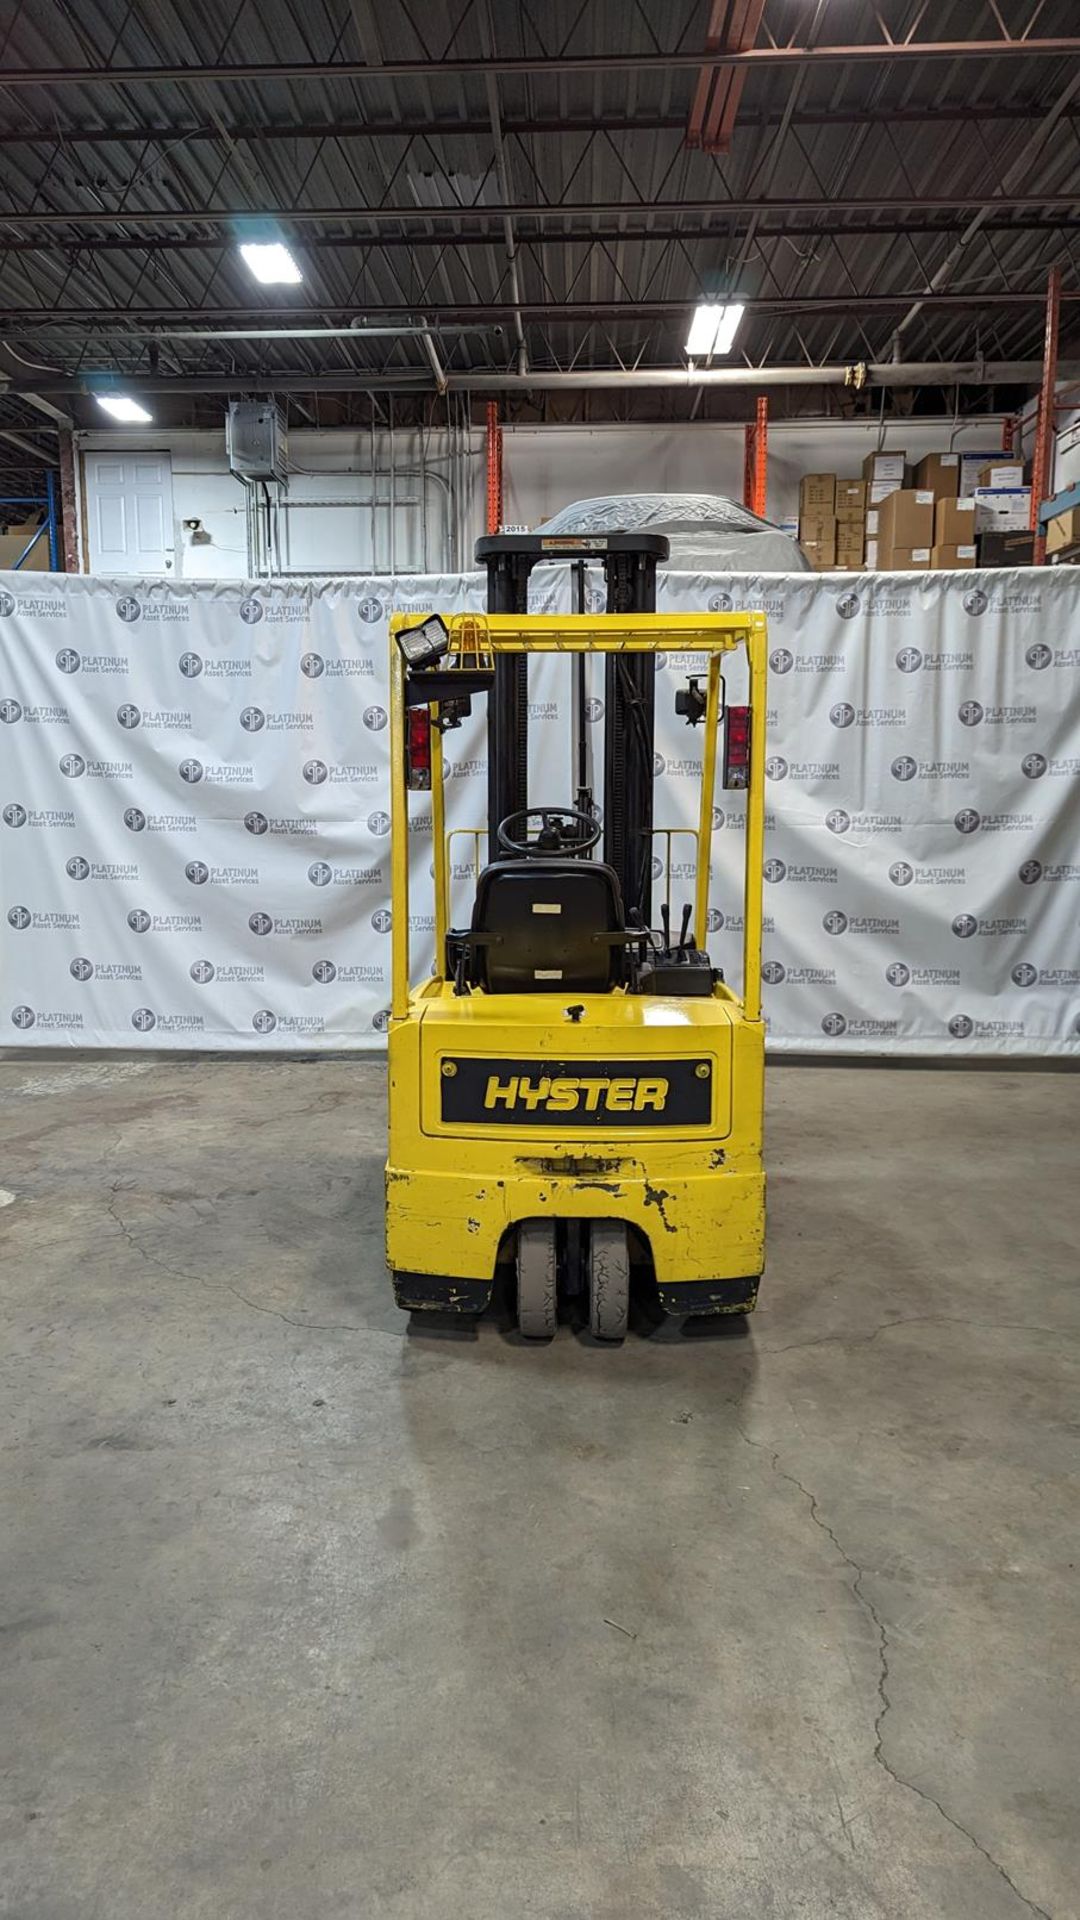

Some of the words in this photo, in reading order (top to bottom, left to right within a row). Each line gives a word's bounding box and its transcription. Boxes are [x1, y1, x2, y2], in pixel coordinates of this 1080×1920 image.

[17, 600, 66, 610] PLATINUM
[142, 605, 189, 614] PLATINUM
[385, 604, 432, 612] PLATINUM
[735, 600, 784, 610] PLATINUM
[17, 610, 37, 618] Asset
[39, 610, 67, 618] Services
[81, 657, 128, 666] PLATINUM
[668, 654, 709, 663] PLATINU
[795, 656, 845, 665] PLATINUM
[205, 660, 251, 669] PLATINUM
[326, 659, 373, 669] PLATINUM
[81, 666, 100, 674] Asset
[102, 666, 129, 674] Services
[204, 669, 223, 677] Asset
[224, 669, 252, 677] Services
[23, 706, 68, 717] PLATINUM
[23, 716, 41, 724] Asset
[43, 716, 70, 724] Services
[142, 712, 191, 721] PLATINUM
[266, 714, 313, 723] PLATINUM
[142, 720, 161, 729] Asset
[163, 720, 192, 729] Services
[266, 722, 284, 730] Asset
[286, 722, 314, 730] Services
[86, 761, 133, 771] PLATINUM
[205, 766, 253, 775] PLATINUM
[329, 766, 377, 775] PLATINUM
[790, 763, 839, 772] PLATINUM
[919, 762, 969, 771] PLATINUM
[86, 770, 104, 778] Asset
[106, 770, 133, 778] Services
[789, 772, 808, 780] Asset
[810, 772, 840, 780] Services
[918, 771, 938, 779] Asset
[940, 771, 970, 779] Services
[28, 811, 74, 820] PLATINUM
[147, 816, 196, 824] PLATINUM
[981, 814, 1032, 824] PLATINUM
[269, 818, 317, 828] PLATINUM
[851, 816, 901, 826] PLATINUM
[147, 824, 166, 832] Asset
[168, 824, 197, 832] Services
[91, 864, 138, 873] PLATINUM
[210, 868, 258, 877] PLATINUM
[333, 869, 382, 877] PLATINUM
[787, 866, 838, 876] PLATINUM
[915, 869, 965, 878] PLATINUM
[787, 875, 807, 883] Asset
[809, 875, 838, 883] Services
[33, 913, 79, 922] PLATINUM
[153, 916, 201, 925] PLATINUM
[274, 919, 322, 928] PLATINUM
[849, 918, 899, 927] PLATINUM
[979, 919, 1027, 928] PLATINUM
[153, 924, 172, 932] Asset
[174, 924, 202, 932] Services
[95, 964, 142, 973] PLATINUM
[216, 966, 264, 975] PLATINUM
[337, 966, 383, 975] PLATINUM
[787, 968, 836, 977] PLATINUM
[912, 970, 960, 978] PLATINUM
[786, 977, 806, 985] Asset
[808, 977, 837, 985] Services
[36, 1013, 83, 1022] PLATINUM
[157, 1015, 204, 1024] PLATINUM
[278, 1016, 324, 1025] PLATINUM
[848, 1020, 897, 1029] PLATINUM
[975, 1021, 1024, 1030] PLATINUM
[484, 1076, 668, 1111] HYSTER
